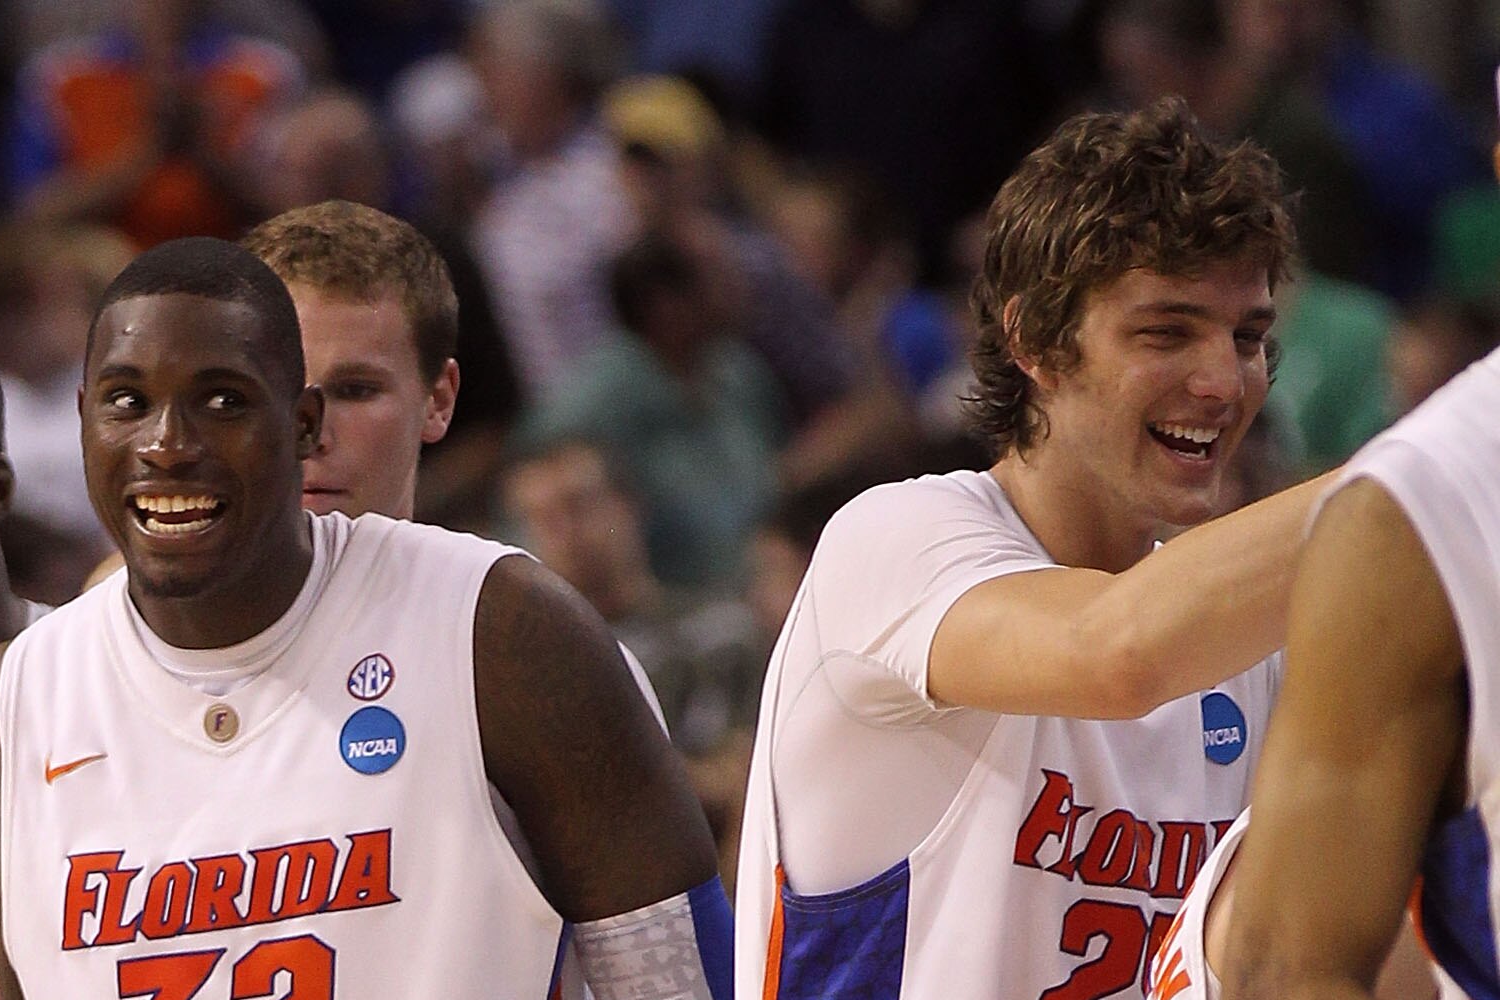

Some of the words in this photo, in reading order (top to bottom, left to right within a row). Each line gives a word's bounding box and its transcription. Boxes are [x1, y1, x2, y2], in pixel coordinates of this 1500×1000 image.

[350, 656, 390, 697] SEC
[349, 738, 398, 758] NCAA
[1203, 726, 1241, 747] NCAA
[62, 828, 402, 951] FLORIDA
